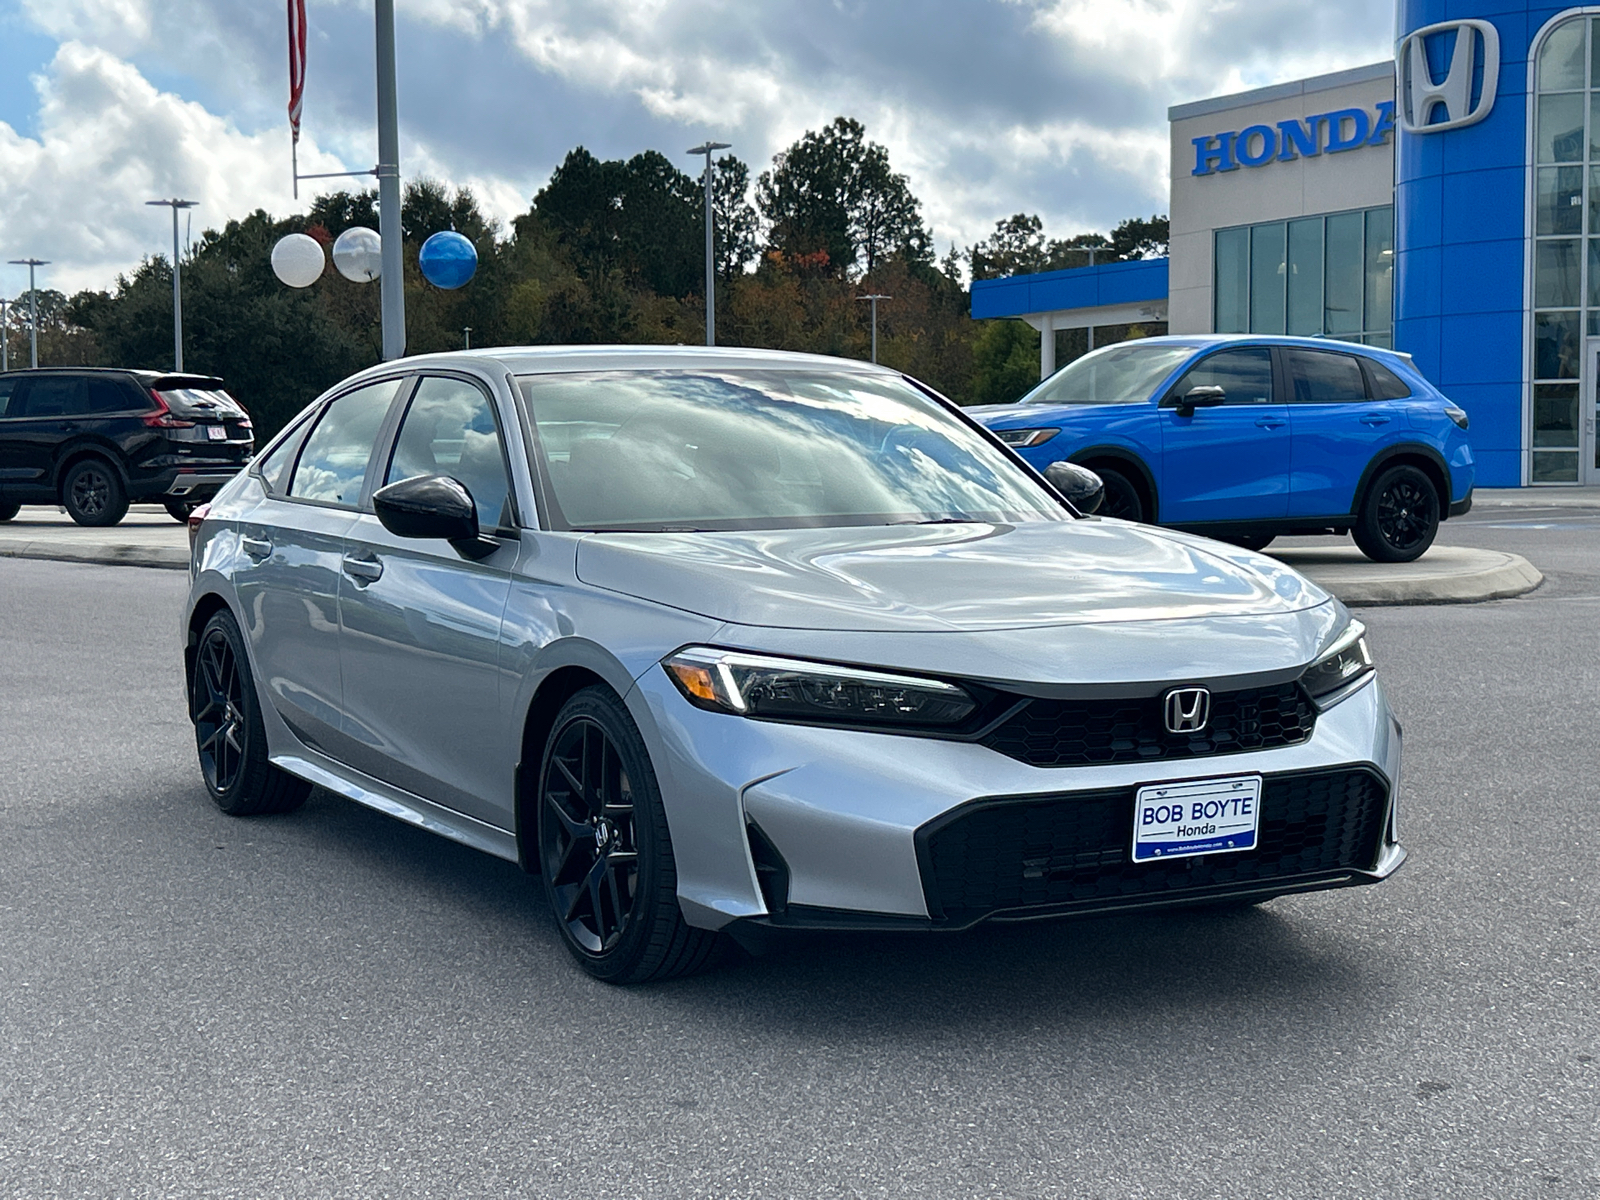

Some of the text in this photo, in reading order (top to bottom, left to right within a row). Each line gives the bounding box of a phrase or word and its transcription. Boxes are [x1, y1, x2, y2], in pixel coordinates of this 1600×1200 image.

[1142, 797, 1253, 825] BOB BOYTE
[1176, 822, 1216, 838] Honda
